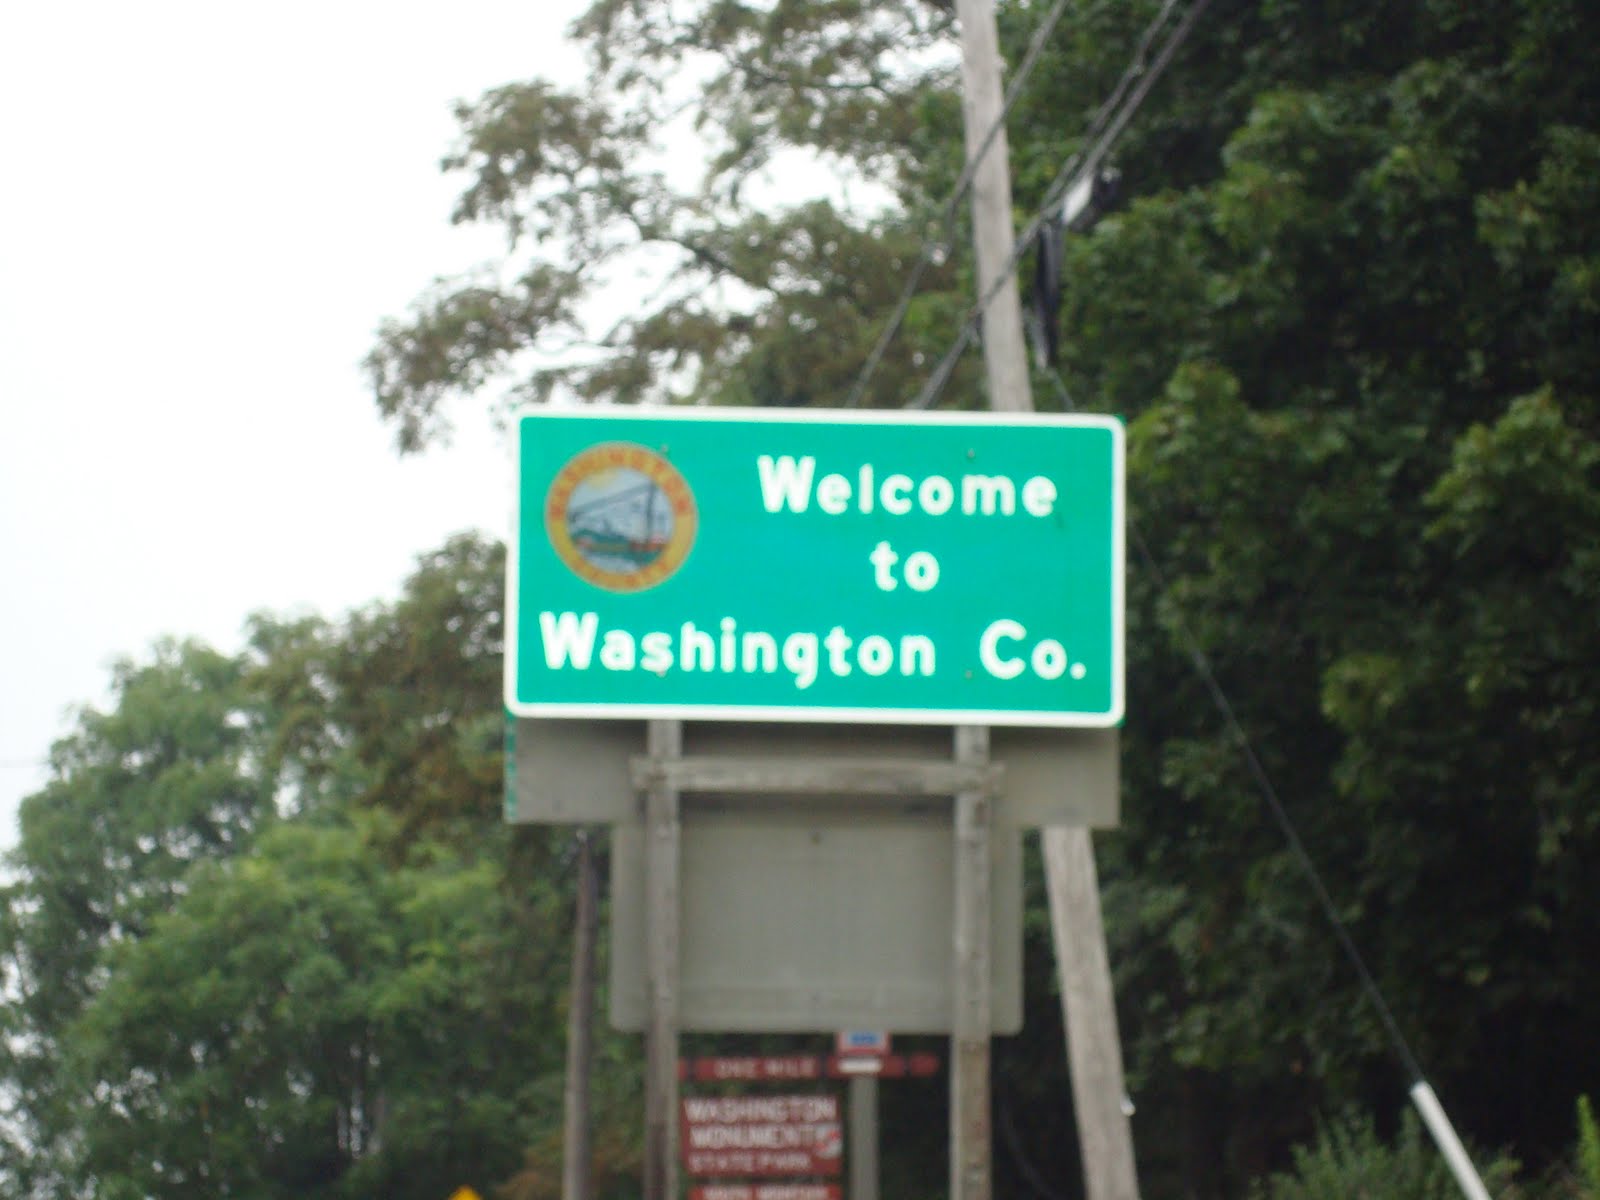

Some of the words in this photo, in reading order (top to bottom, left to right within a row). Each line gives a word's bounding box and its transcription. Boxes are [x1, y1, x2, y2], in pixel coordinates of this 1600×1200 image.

[757, 455, 1058, 517] Welcome
[869, 540, 941, 592] to
[539, 611, 937, 690] Washington
[979, 618, 1087, 680] Co.
[685, 1097, 836, 1122] WASHINGTON
[690, 1125, 815, 1148] MONUMENT
